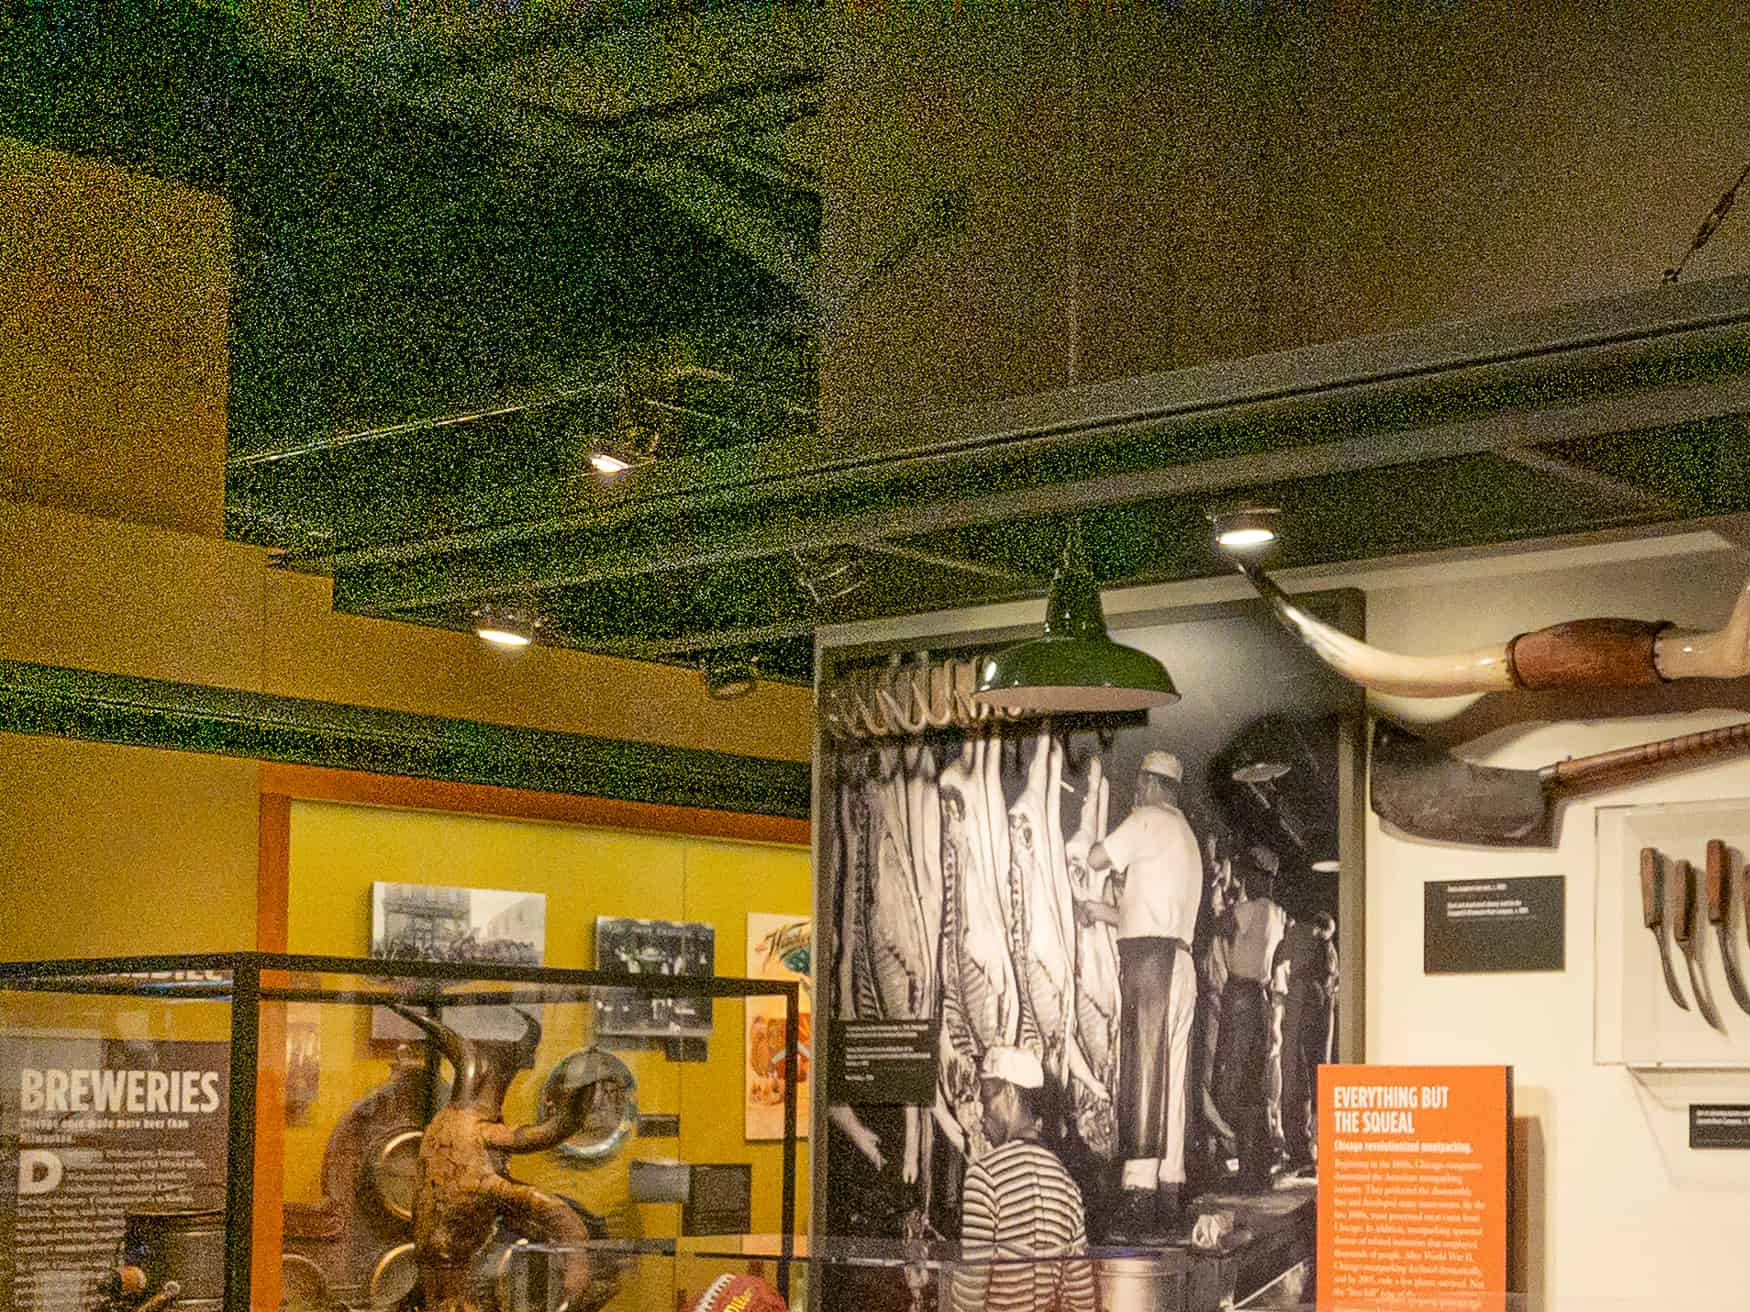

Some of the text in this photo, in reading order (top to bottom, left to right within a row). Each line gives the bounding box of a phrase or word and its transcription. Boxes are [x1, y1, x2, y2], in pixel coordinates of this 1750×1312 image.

[20, 1069, 220, 1113] BREWERIES
[1334, 1087, 1449, 1109] EVERYTHING BUT
[1334, 1112, 1415, 1134] THE SQUEAL
[18, 1150, 63, 1194] D
